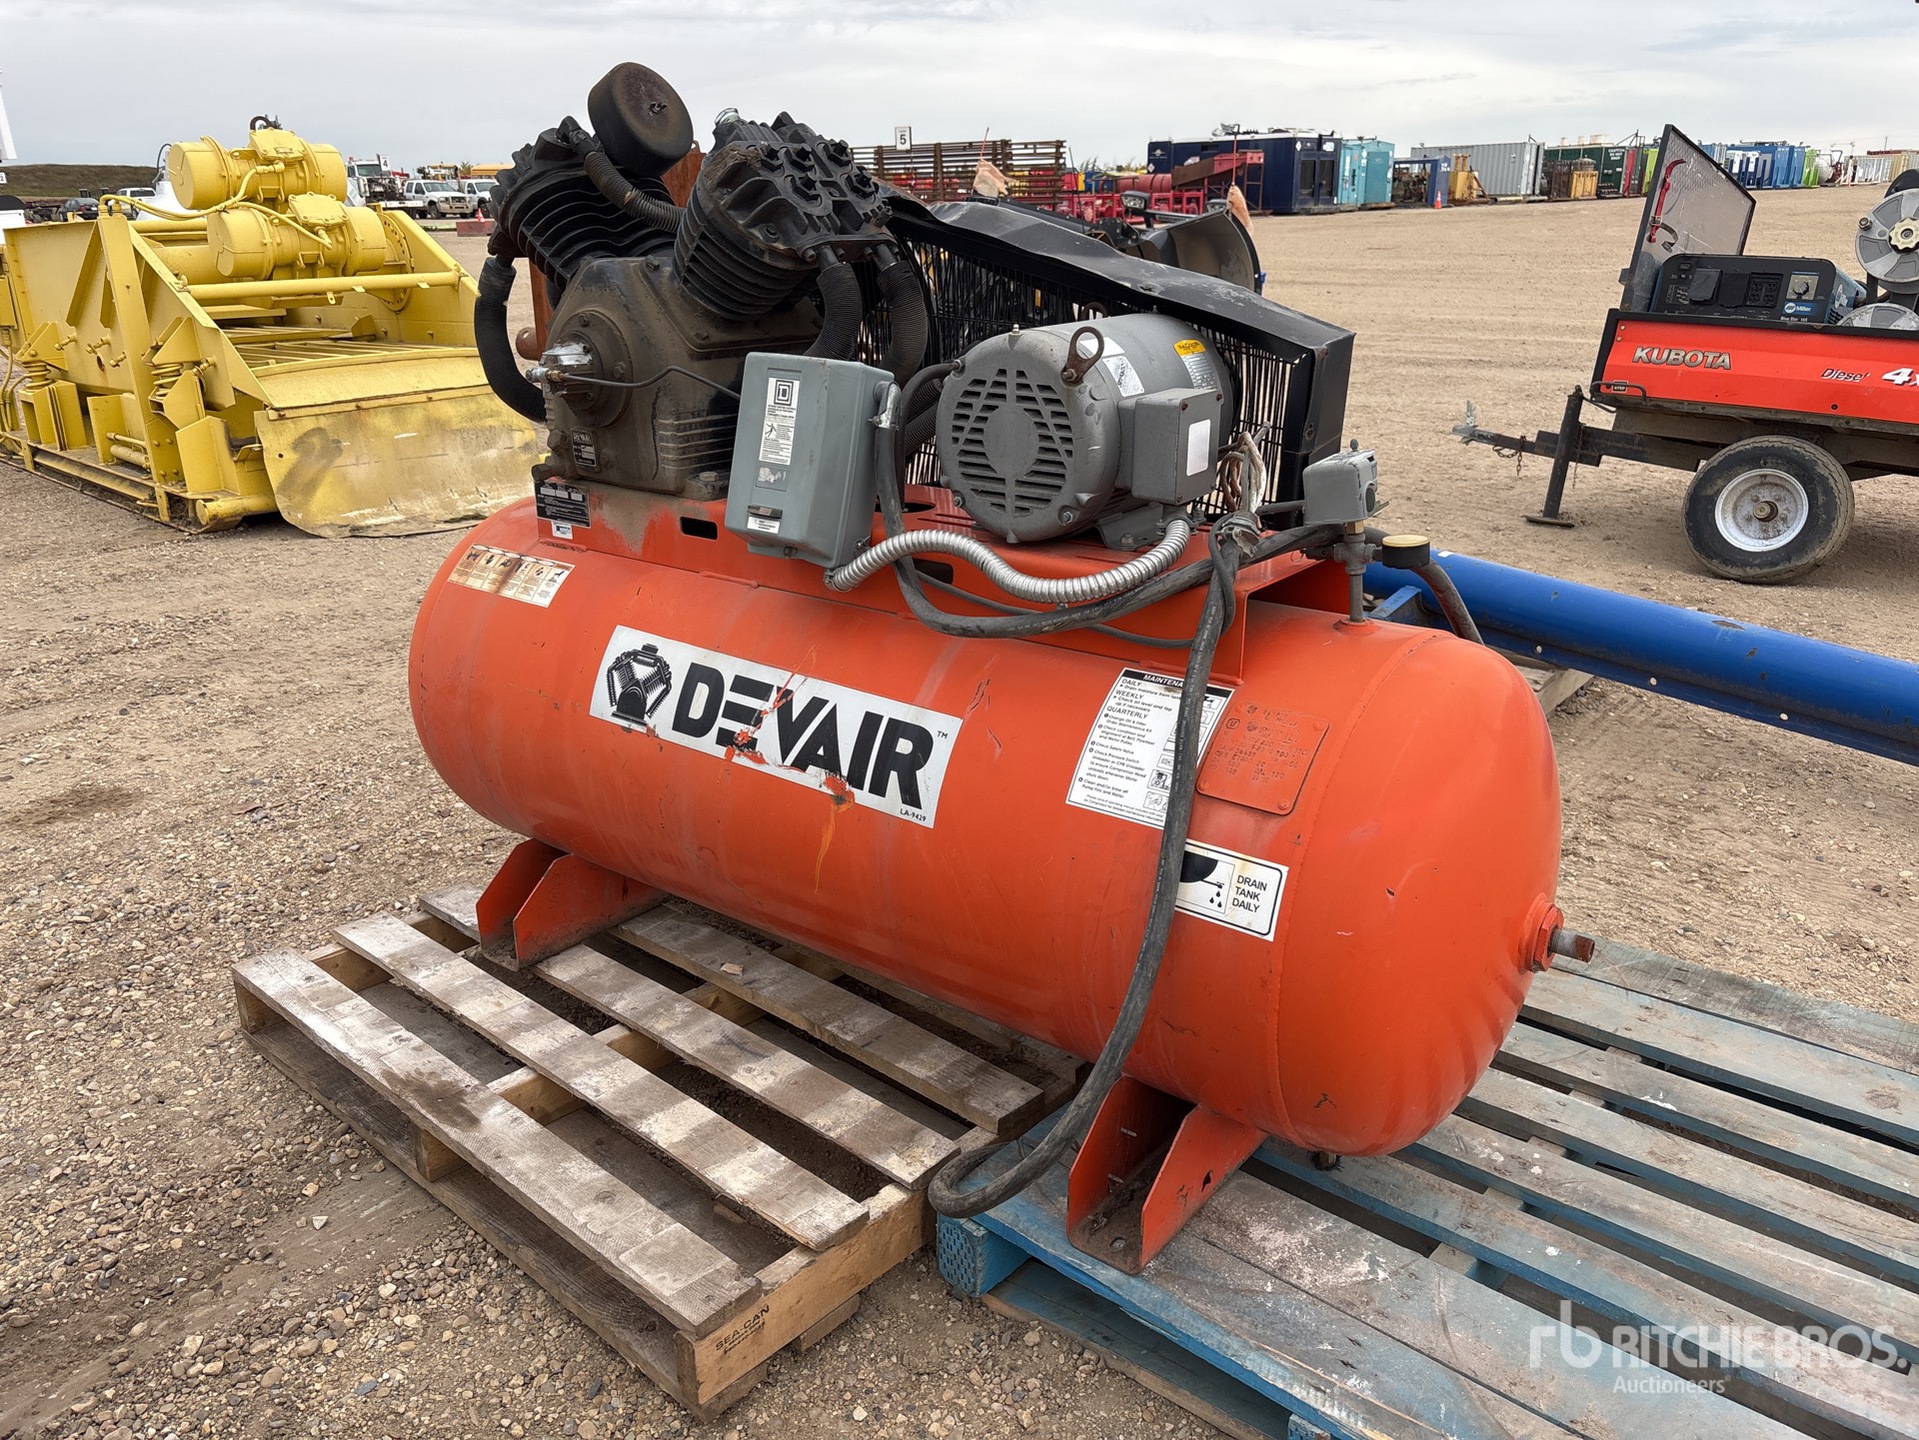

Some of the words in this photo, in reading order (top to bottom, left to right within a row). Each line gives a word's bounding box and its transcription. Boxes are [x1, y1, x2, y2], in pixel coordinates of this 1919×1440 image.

[900, 133, 907, 145] 5
[1632, 346, 1731, 370] KUBOTA
[1121, 679, 1141, 687] DAILY
[1143, 674, 1184, 687] MAINTENA
[1115, 690, 1144, 700] WEEKLY
[1118, 696, 1133, 704] Check
[1107, 706, 1148, 719] QUARTERLY
[1126, 704, 1151, 713] necessary
[1103, 724, 1116, 732] Check
[671, 662, 935, 810] DEVAIR
[1095, 741, 1109, 749] Check
[1094, 749, 1108, 757] Check
[1236, 875, 1268, 892] DRAIN
[1235, 886, 1261, 902] TANK
[1232, 897, 1260, 913] DAILY
[716, 1305, 770, 1351] SEA-CAN
